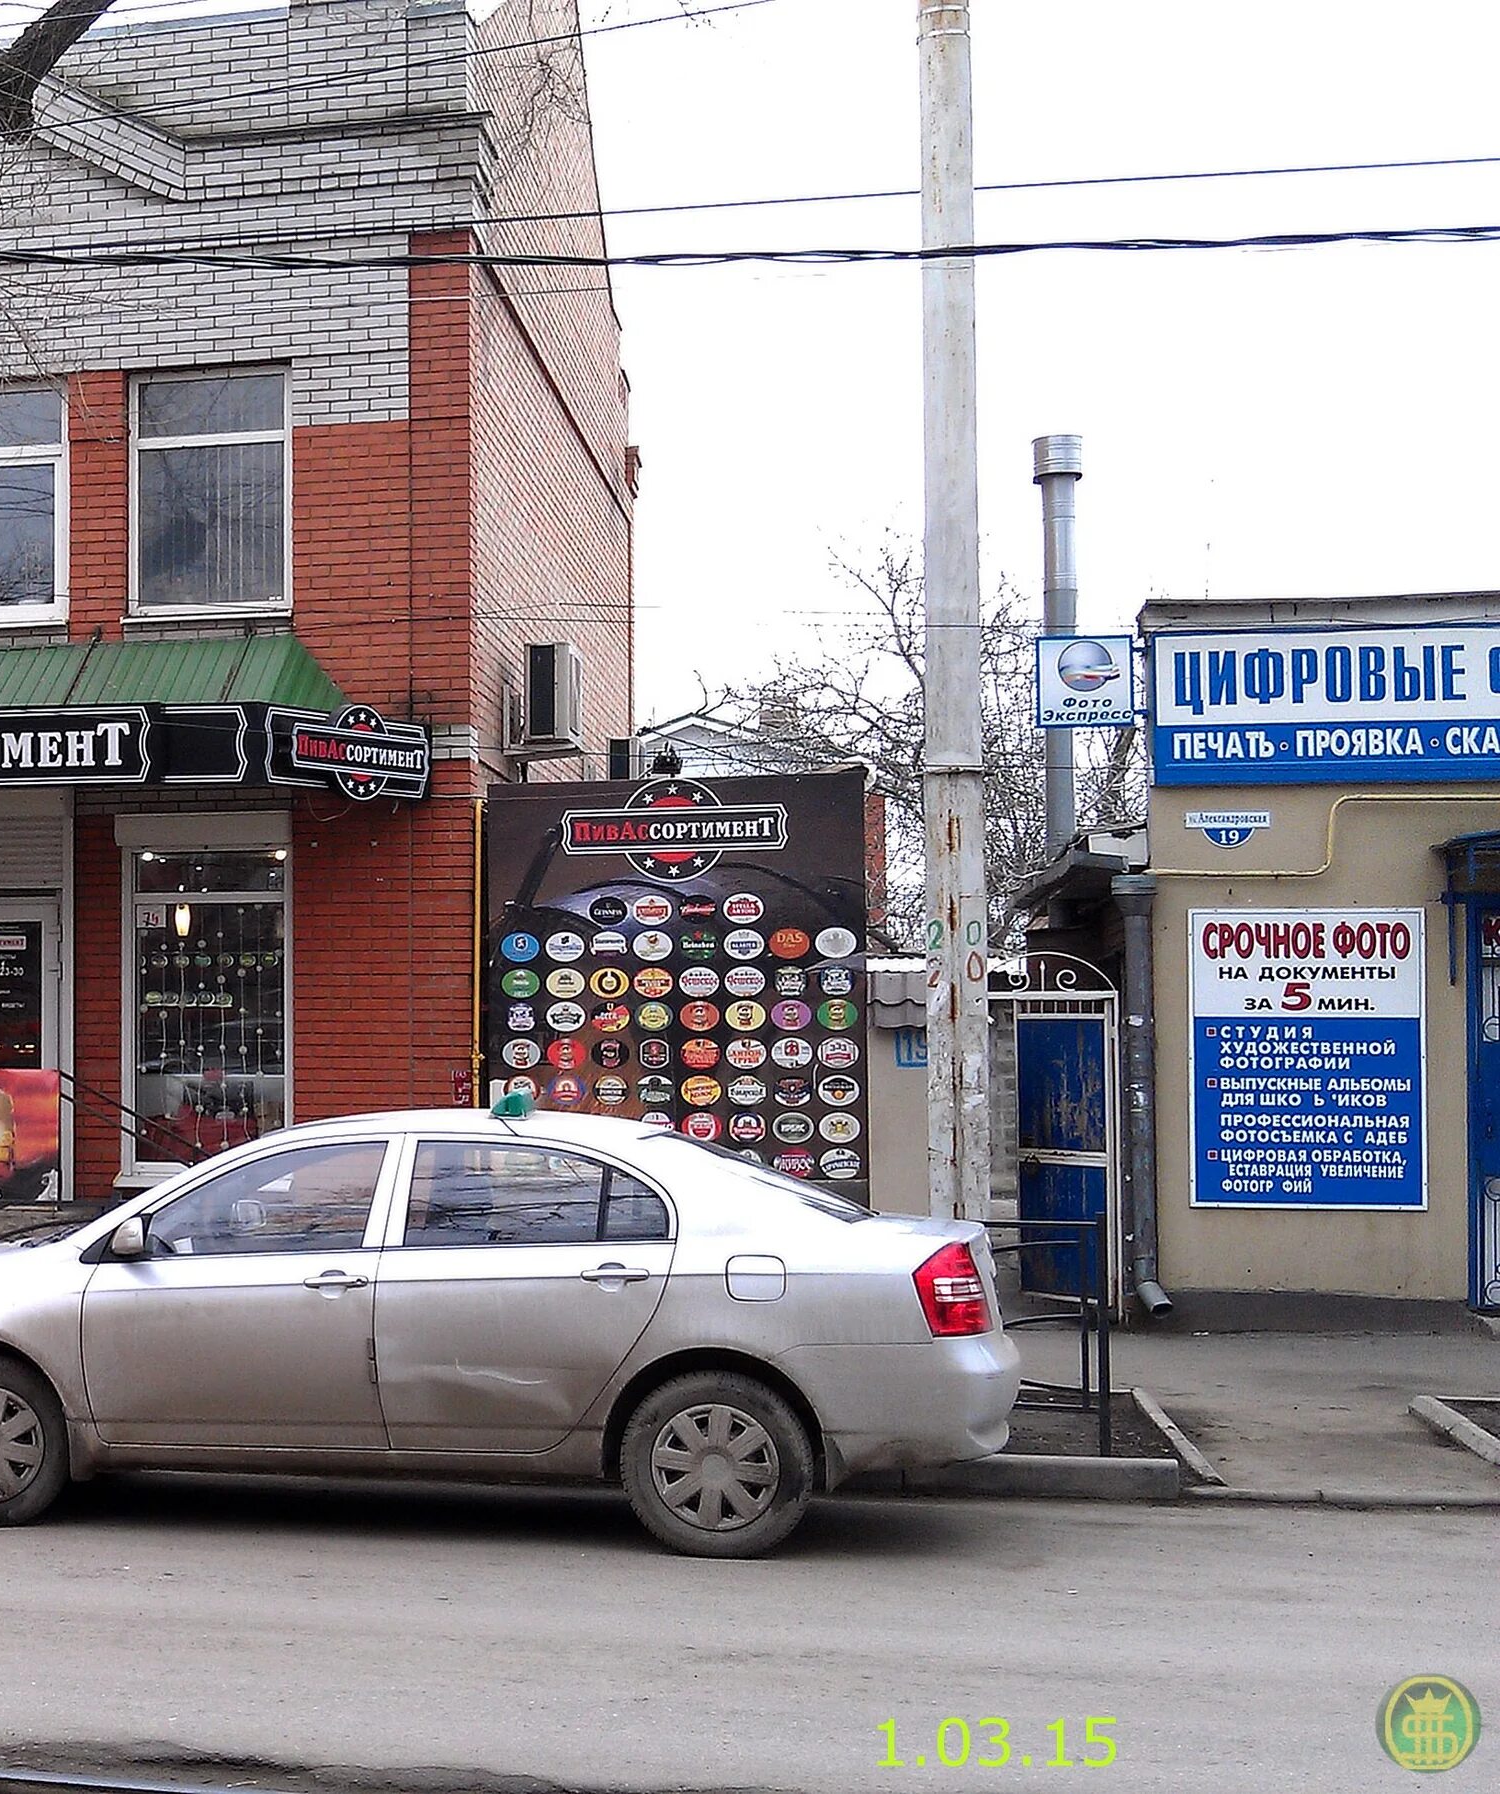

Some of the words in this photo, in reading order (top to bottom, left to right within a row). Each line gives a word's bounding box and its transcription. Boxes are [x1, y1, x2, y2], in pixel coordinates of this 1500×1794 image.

[1174, 644, 1466, 715] ЦИФРОВЫЕ
[1062, 697, 1113, 709] Фото
[1042, 709, 1133, 723] Экспресс
[1173, 731, 1275, 760] ПЕЧАТЬ
[1296, 727, 1424, 757] ПРОЯВКА
[1219, 829, 1240, 845] 19
[777, 931, 803, 943] DAS
[928, 919, 944, 950] 2
[1202, 921, 1326, 960] СРОЧНОЕ
[1332, 921, 1411, 960] ФОТО
[682, 938, 715, 949] Heineken
[1218, 966, 1249, 980] НА
[1258, 966, 1397, 982] ДОКУМЕНТЫ
[1244, 998, 1273, 1011] ЗА
[1280, 981, 1312, 1012] 5
[1219, 1025, 1314, 1041] СТУДИЯ
[1219, 1038, 1397, 1056] ХУДОЖЕСТВЕННОЙ
[1219, 1056, 1351, 1070] ФОТОГРАФИИ
[1219, 1077, 1323, 1092] ВЫПУСКНЫЕ
[1326, 1077, 1412, 1093] АЛЬБОМЫ
[1220, 1093, 1255, 1108] ДЛЯ
[1219, 1113, 1410, 1128] ПРОФЕССИОНАЛЬНАЯ
[1219, 1129, 1338, 1144] ФОТОСЪЕМКА
[1221, 1149, 1308, 1163] ЦИФРОВАЯ
[1311, 1149, 1408, 1166] ОБРАБОТКА,
[1320, 1164, 1405, 1179] УВЕЛИЧЕНИЕ
